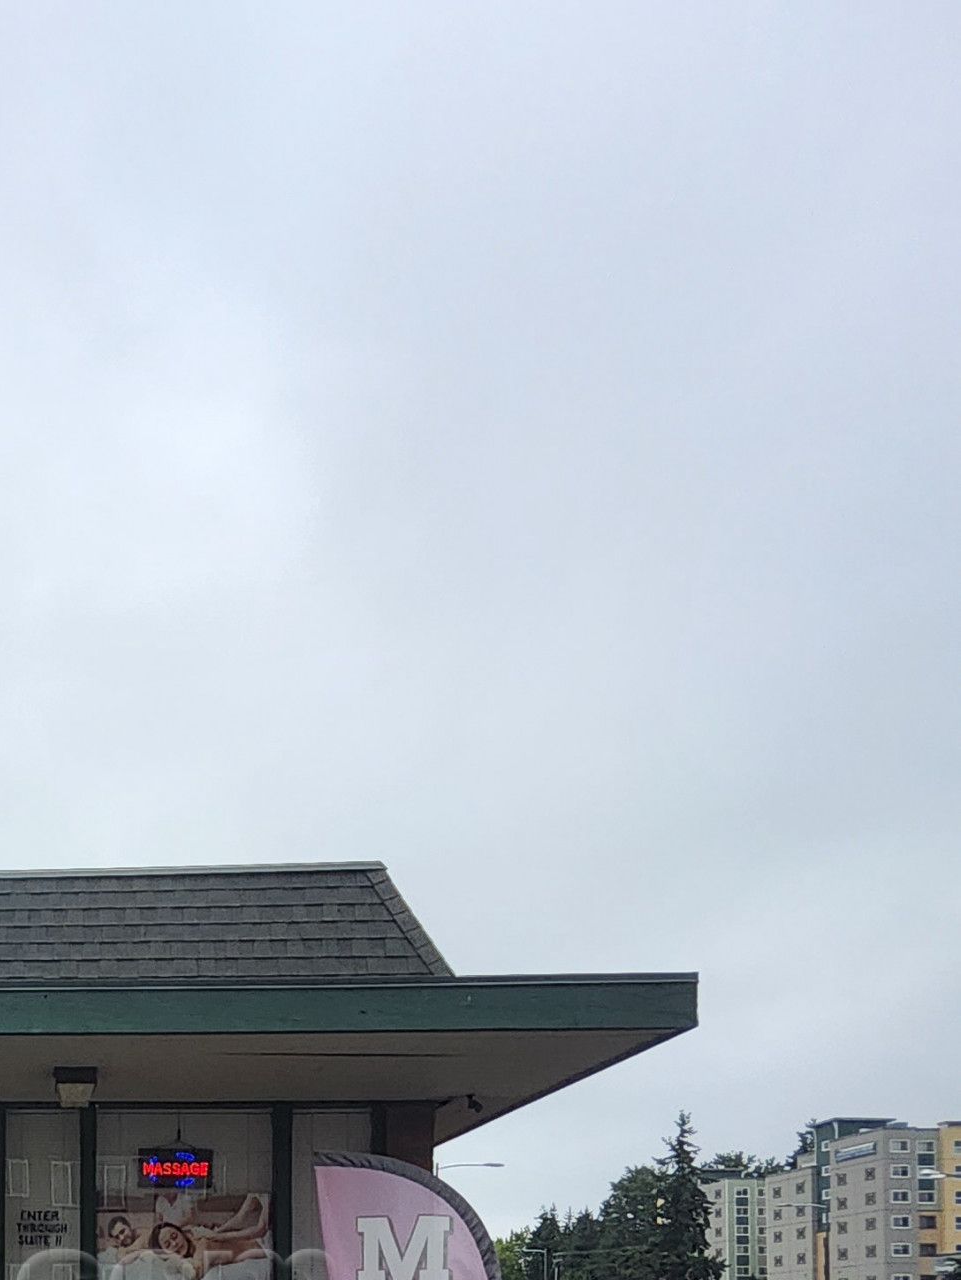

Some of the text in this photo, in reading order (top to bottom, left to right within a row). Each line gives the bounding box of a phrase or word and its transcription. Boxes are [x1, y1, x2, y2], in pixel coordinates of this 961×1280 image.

[143, 1162, 209, 1176] MASSAGE
[20, 1210, 59, 1221] ENTER
[18, 1235, 50, 1247] SUITE
